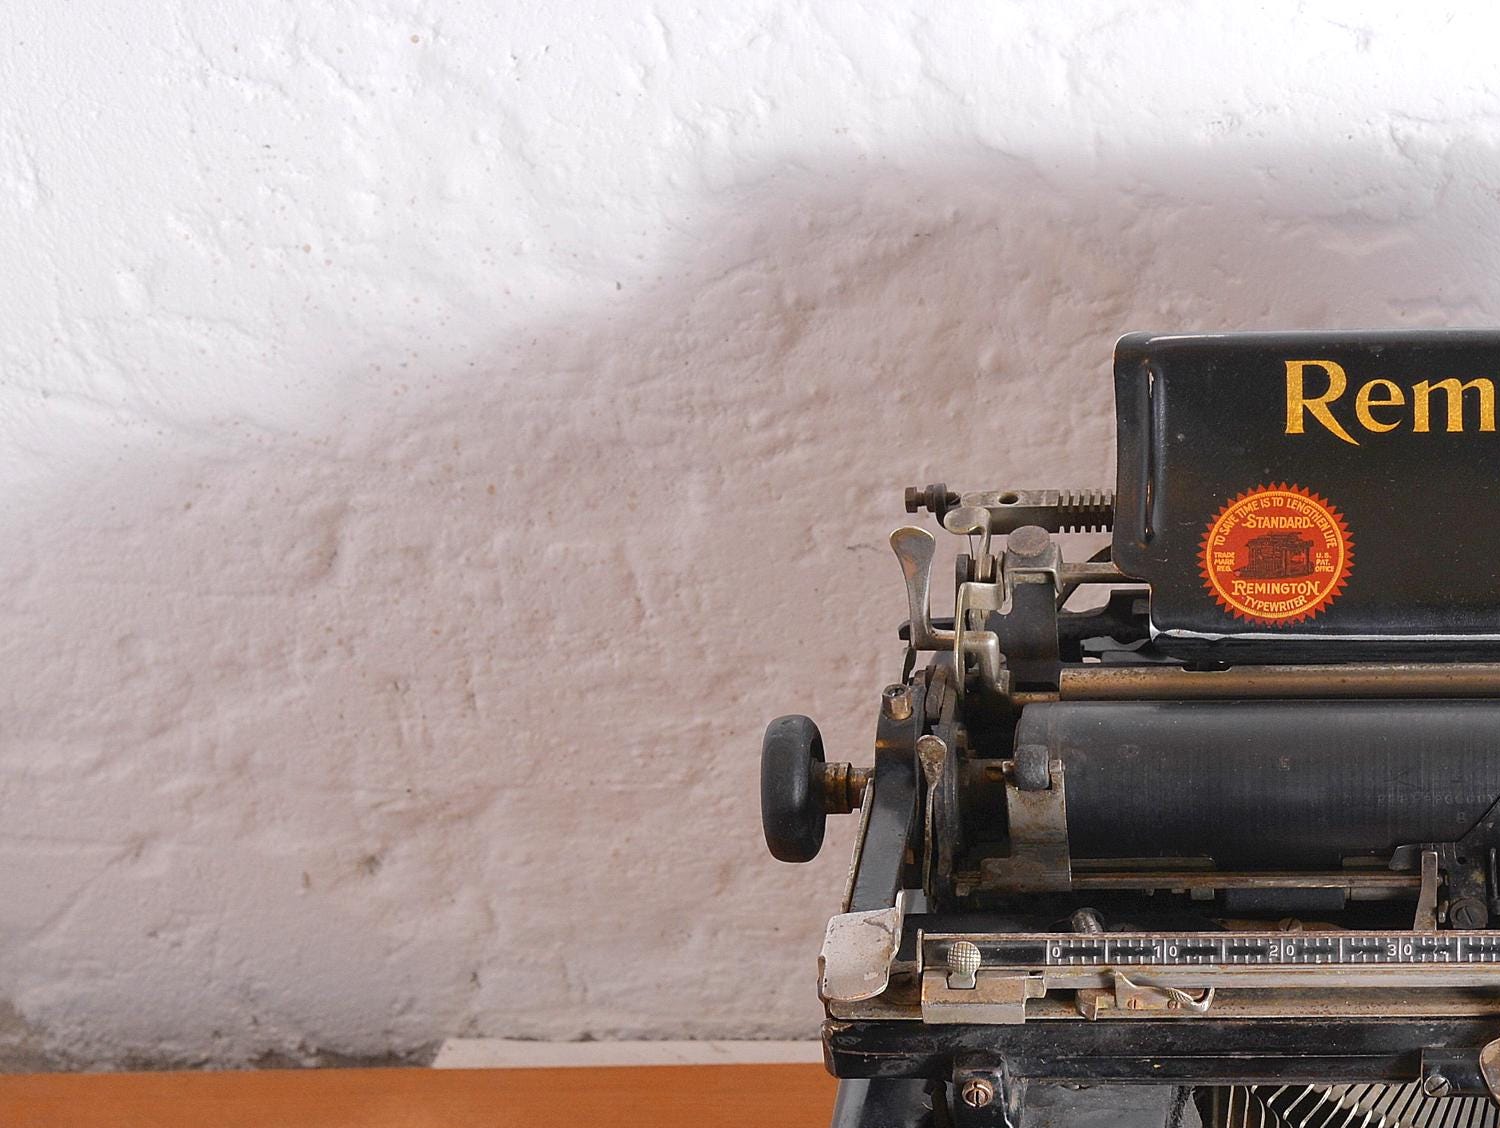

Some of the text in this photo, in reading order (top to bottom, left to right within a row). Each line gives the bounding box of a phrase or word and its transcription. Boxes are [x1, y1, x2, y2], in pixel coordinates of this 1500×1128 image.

[1213, 497, 1338, 549] TO SAVE TIME IS TO LENGTHEN LIFE
[1314, 565, 1335, 573] OFFICE
[1231, 580, 1320, 596] REMINGTON
[1244, 595, 1307, 612] TYPEWRITER
[1051, 945, 1061, 959] 0
[1153, 945, 1178, 958] 10
[1268, 944, 1296, 958] 20
[1387, 943, 1413, 957] 30
